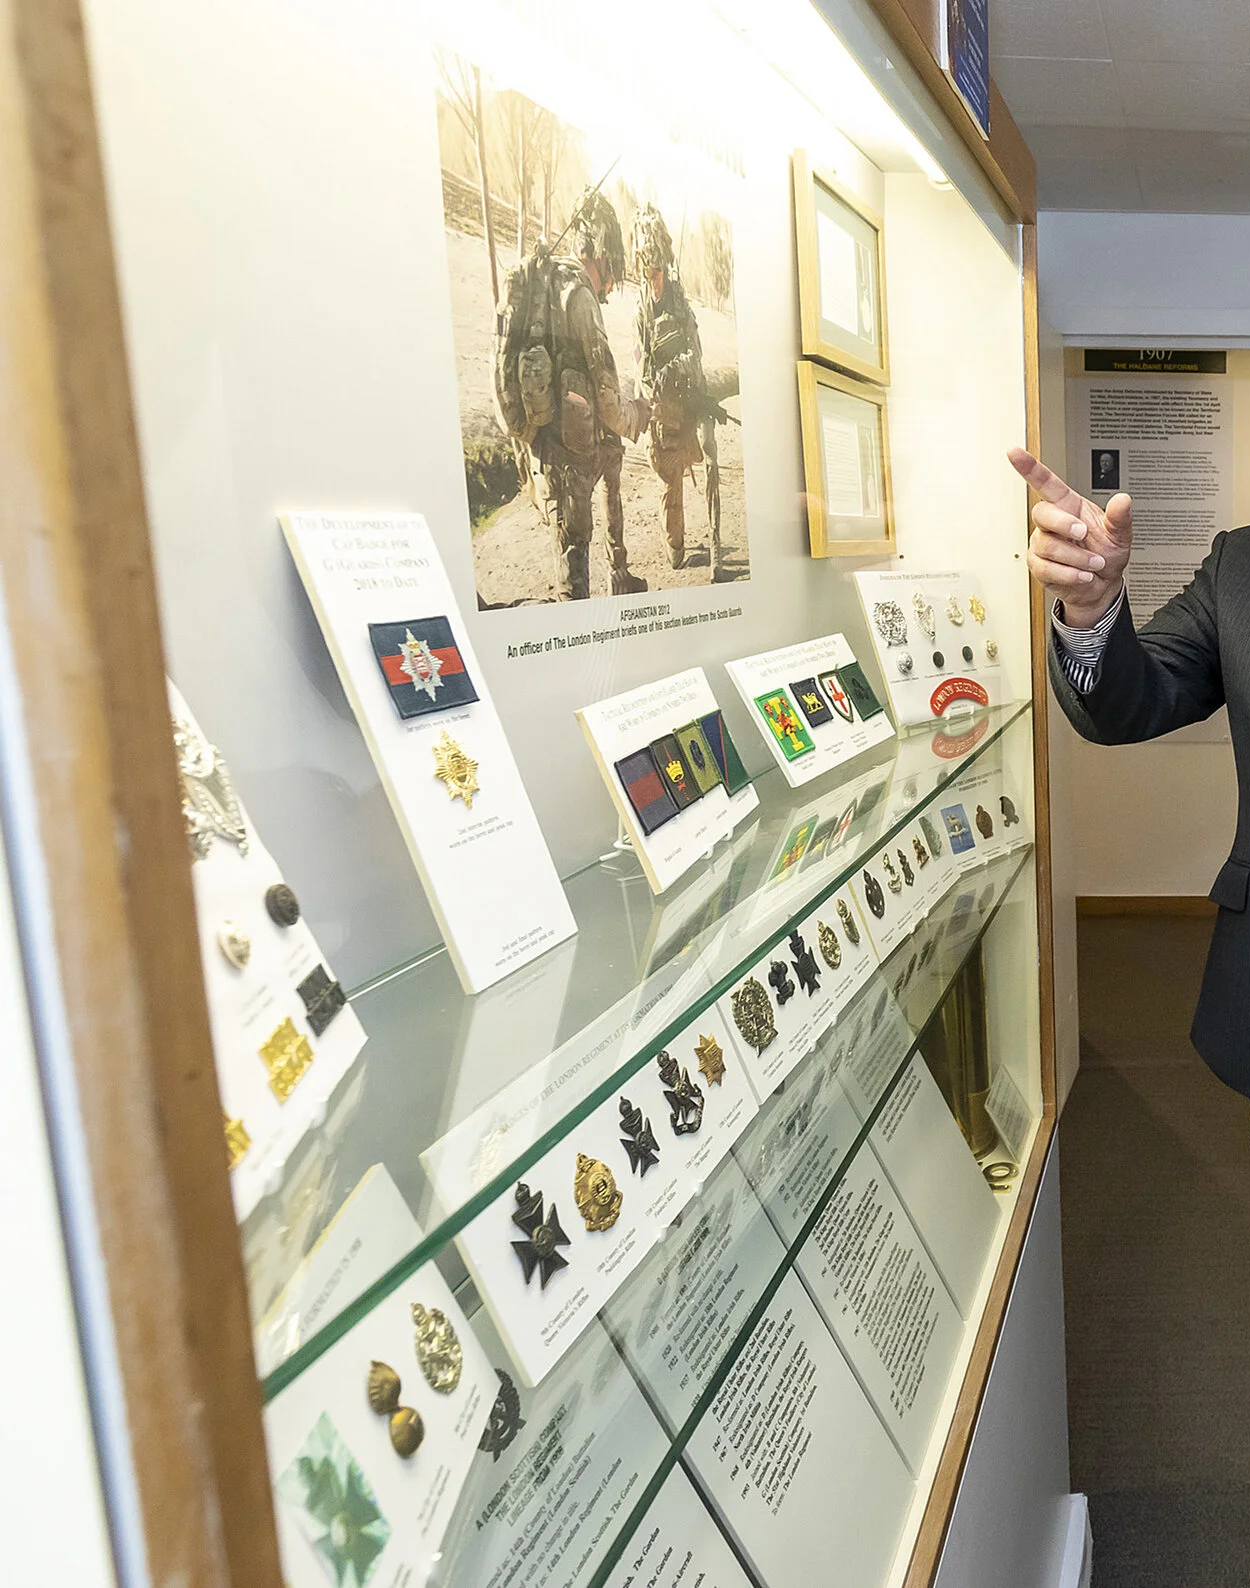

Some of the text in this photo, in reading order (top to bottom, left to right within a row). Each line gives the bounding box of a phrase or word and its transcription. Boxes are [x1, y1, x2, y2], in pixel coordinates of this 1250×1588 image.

[1139, 349, 1174, 361] 1907
[507, 645, 519, 659] An
[519, 639, 544, 656] officer
[544, 637, 553, 652] of
[553, 636, 567, 651] The
[567, 631, 591, 648] London
[592, 626, 621, 644] Regiment
[621, 622, 638, 637] briefs
[638, 623, 648, 635] one
[649, 620, 655, 633] of
[655, 619, 663, 631] his
[663, 616, 681, 630] section
[682, 613, 698, 627] leaders
[699, 611, 710, 623] from
[728, 606, 743, 619] Guards
[620, 604, 670, 622] AFGHANISTAN 2012
[540, 1086, 555, 1101] THE
[555, 1061, 583, 1089] LONDON
[582, 1035, 614, 1066] REGIMENT
[715, 1400, 730, 1423] London
[728, 1386, 738, 1401] Irish
[749, 1346, 760, 1363] Royal
[766, 1320, 775, 1333] Rifles
[716, 1386, 728, 1405] Royal
[735, 1357, 745, 1372] Rifles
[782, 1377, 792, 1394] Royal
[789, 1366, 798, 1379] Irish
[732, 1433, 744, 1452] North
[742, 1419, 752, 1434] Irish
[475, 1519, 483, 1531] A
[481, 1480, 510, 1522] (LONDON
[539, 1403, 567, 1441] COMPANY
[494, 1429, 561, 1521] THE LONDON REGIMENT
[507, 1488, 534, 1526] LINEAGE
[532, 1464, 550, 1491] FROM
[782, 1479, 790, 1491] The
[788, 1457, 800, 1480] London
[501, 1455, 591, 1588] ondon Regiment (London Scottish)
[509, 1536, 524, 1555] 14th
[523, 1505, 546, 1537] (County
[545, 1491, 552, 1504] of
[550, 1463, 573, 1495] London)
[546, 1553, 560, 1572] 14th
[558, 1522, 580, 1554] London
[578, 1486, 602, 1522] Regiment
[601, 1457, 622, 1488] (London
[571, 1546, 593, 1578] London
[610, 1499, 621, 1514] The
[619, 1472, 638, 1499] Gordon
[765, 1493, 773, 1505] The
[525, 1563, 538, 1580] with
[536, 1551, 545, 1564] no
[544, 1524, 562, 1552] change
[561, 1516, 569, 1525] in
[633, 1527, 660, 1571] The Gordon
[655, 1546, 673, 1575] Gordon
